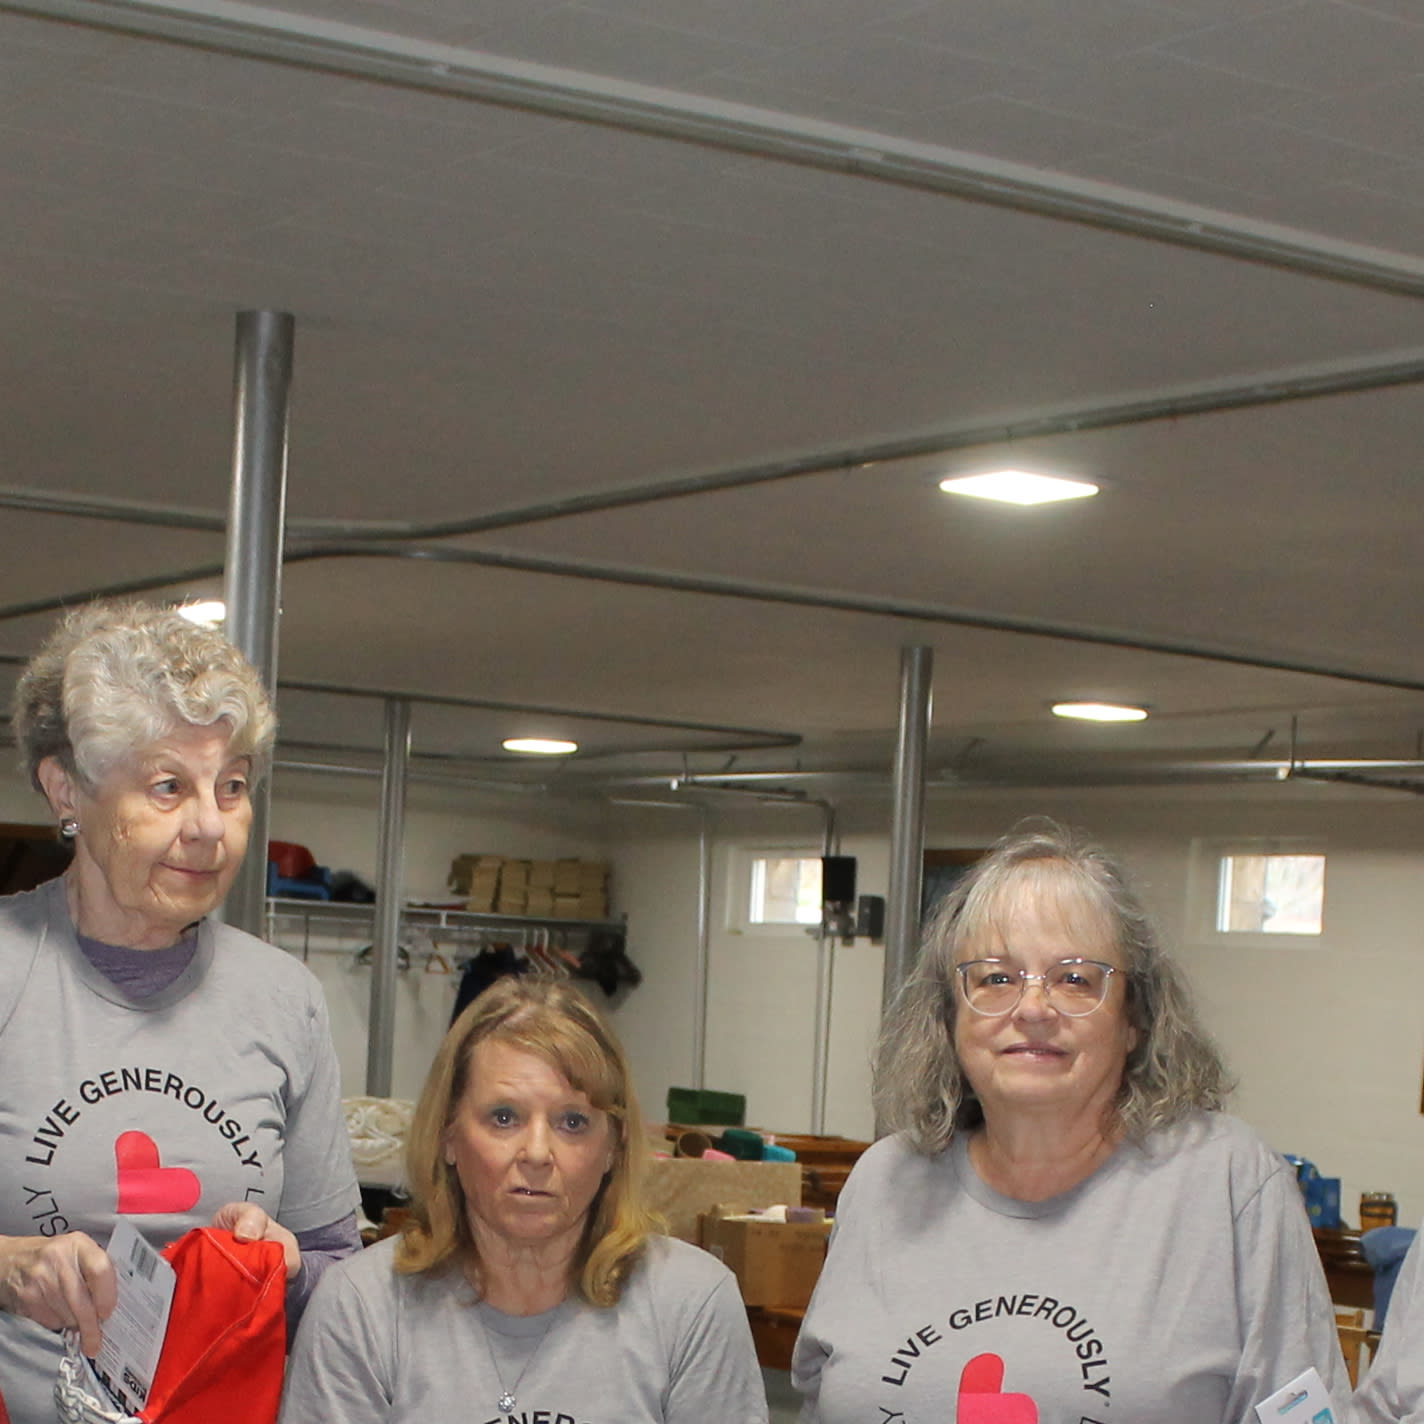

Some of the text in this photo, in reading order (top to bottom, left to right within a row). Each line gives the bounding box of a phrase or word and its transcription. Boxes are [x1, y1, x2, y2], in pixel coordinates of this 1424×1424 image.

[26, 1067, 263, 1169] LIVE GENEROUSLY
[881, 1294, 1111, 1398] LIVE GENEROUSLY
